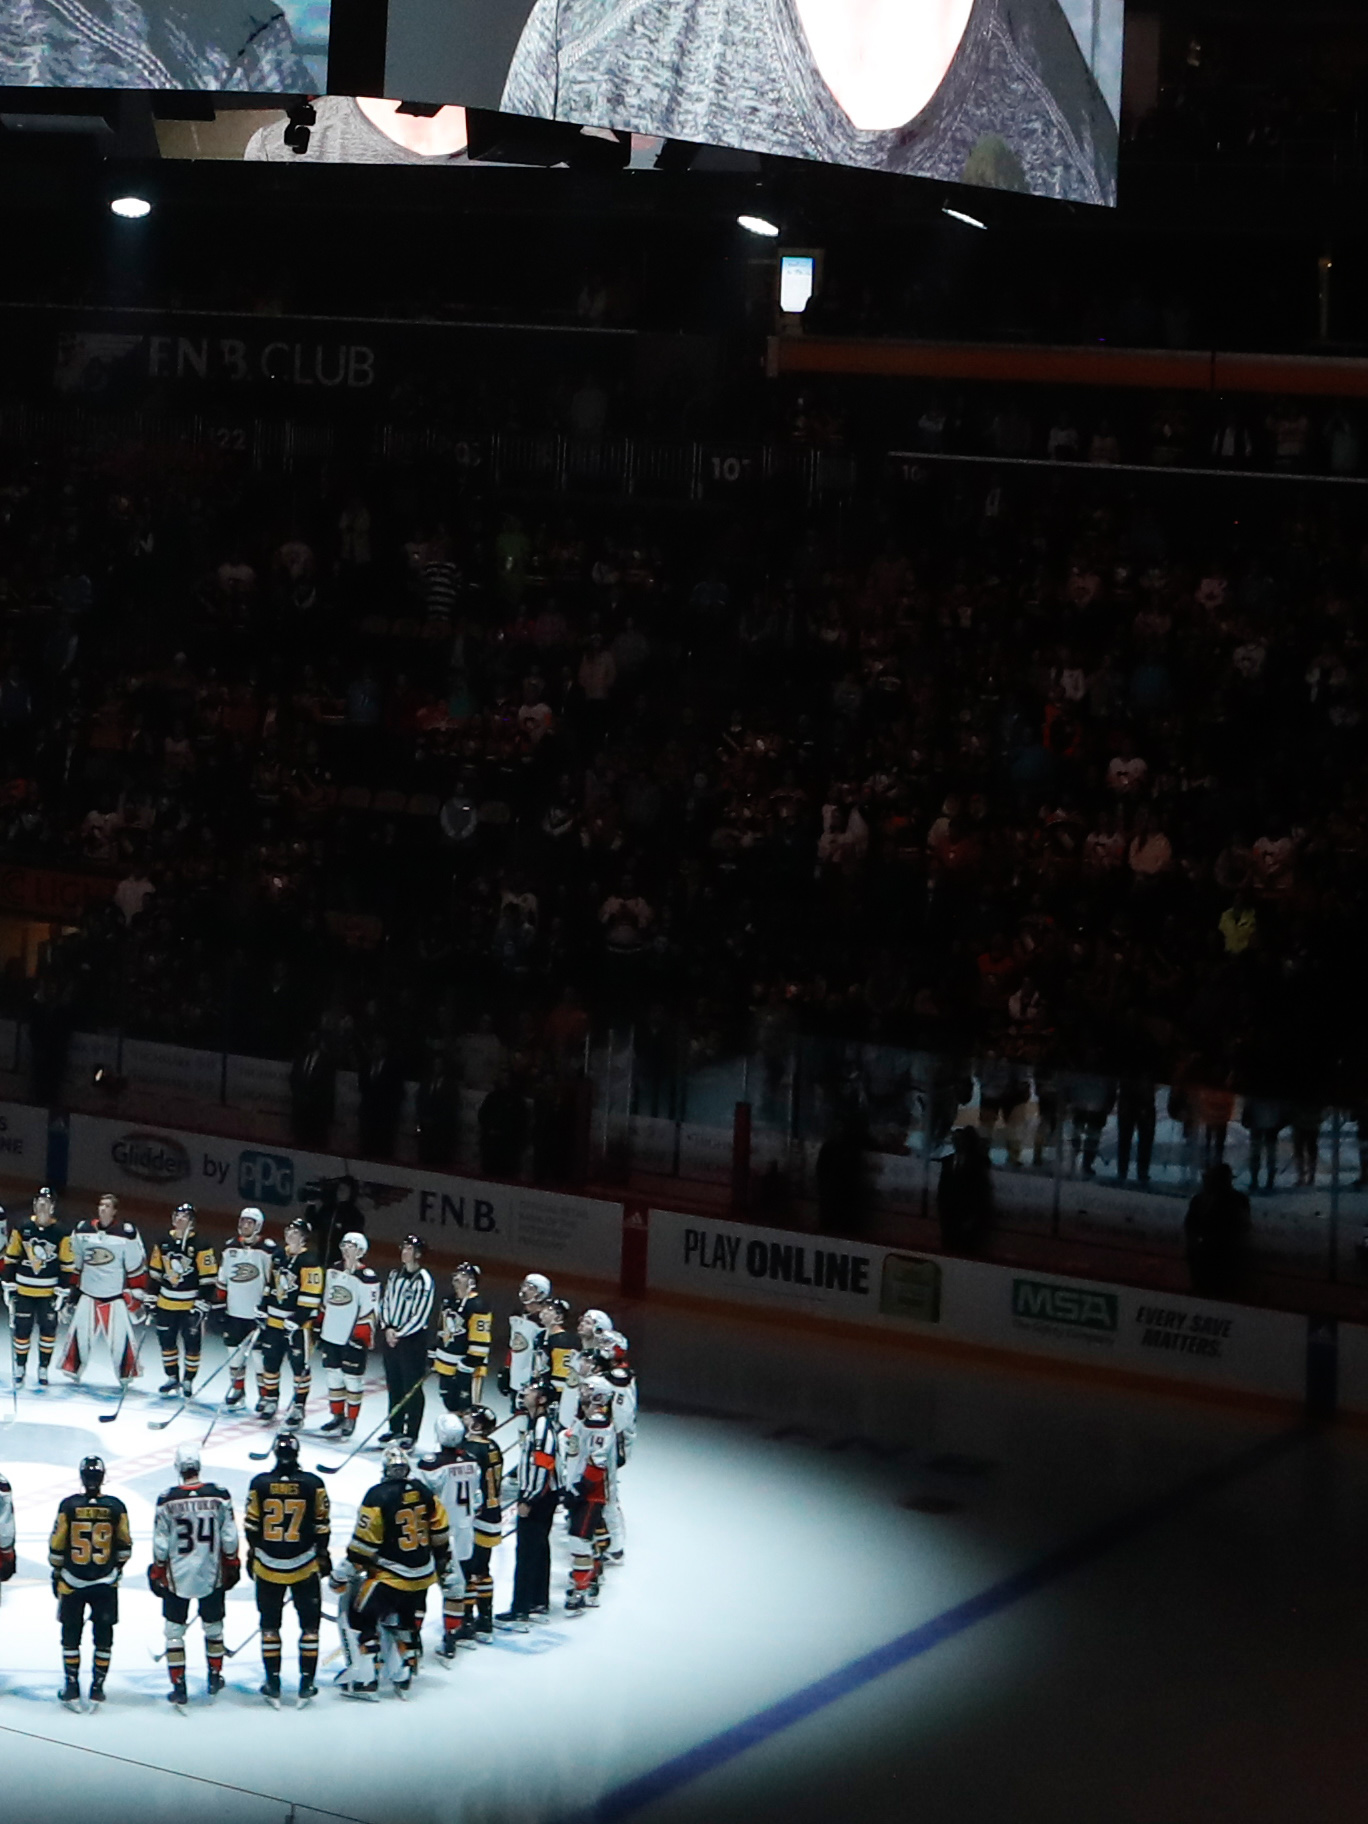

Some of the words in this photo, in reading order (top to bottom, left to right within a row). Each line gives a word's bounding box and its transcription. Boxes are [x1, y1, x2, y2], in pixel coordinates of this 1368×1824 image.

[260, 341, 376, 389] CLUB
[203, 1152, 231, 1185] by
[239, 1154, 293, 1200] PPG
[684, 1228, 742, 1271] PLAY
[745, 1239, 871, 1295] ONLINE
[1016, 1283, 1113, 1328] MSA
[1135, 1306, 1188, 1331] EVERY
[1190, 1314, 1234, 1339] SAVE
[262, 1498, 307, 1543] 27
[456, 1479, 471, 1517] 4
[70, 1521, 114, 1565] 59
[175, 1516, 216, 1555] 34
[394, 1504, 430, 1552] 35
